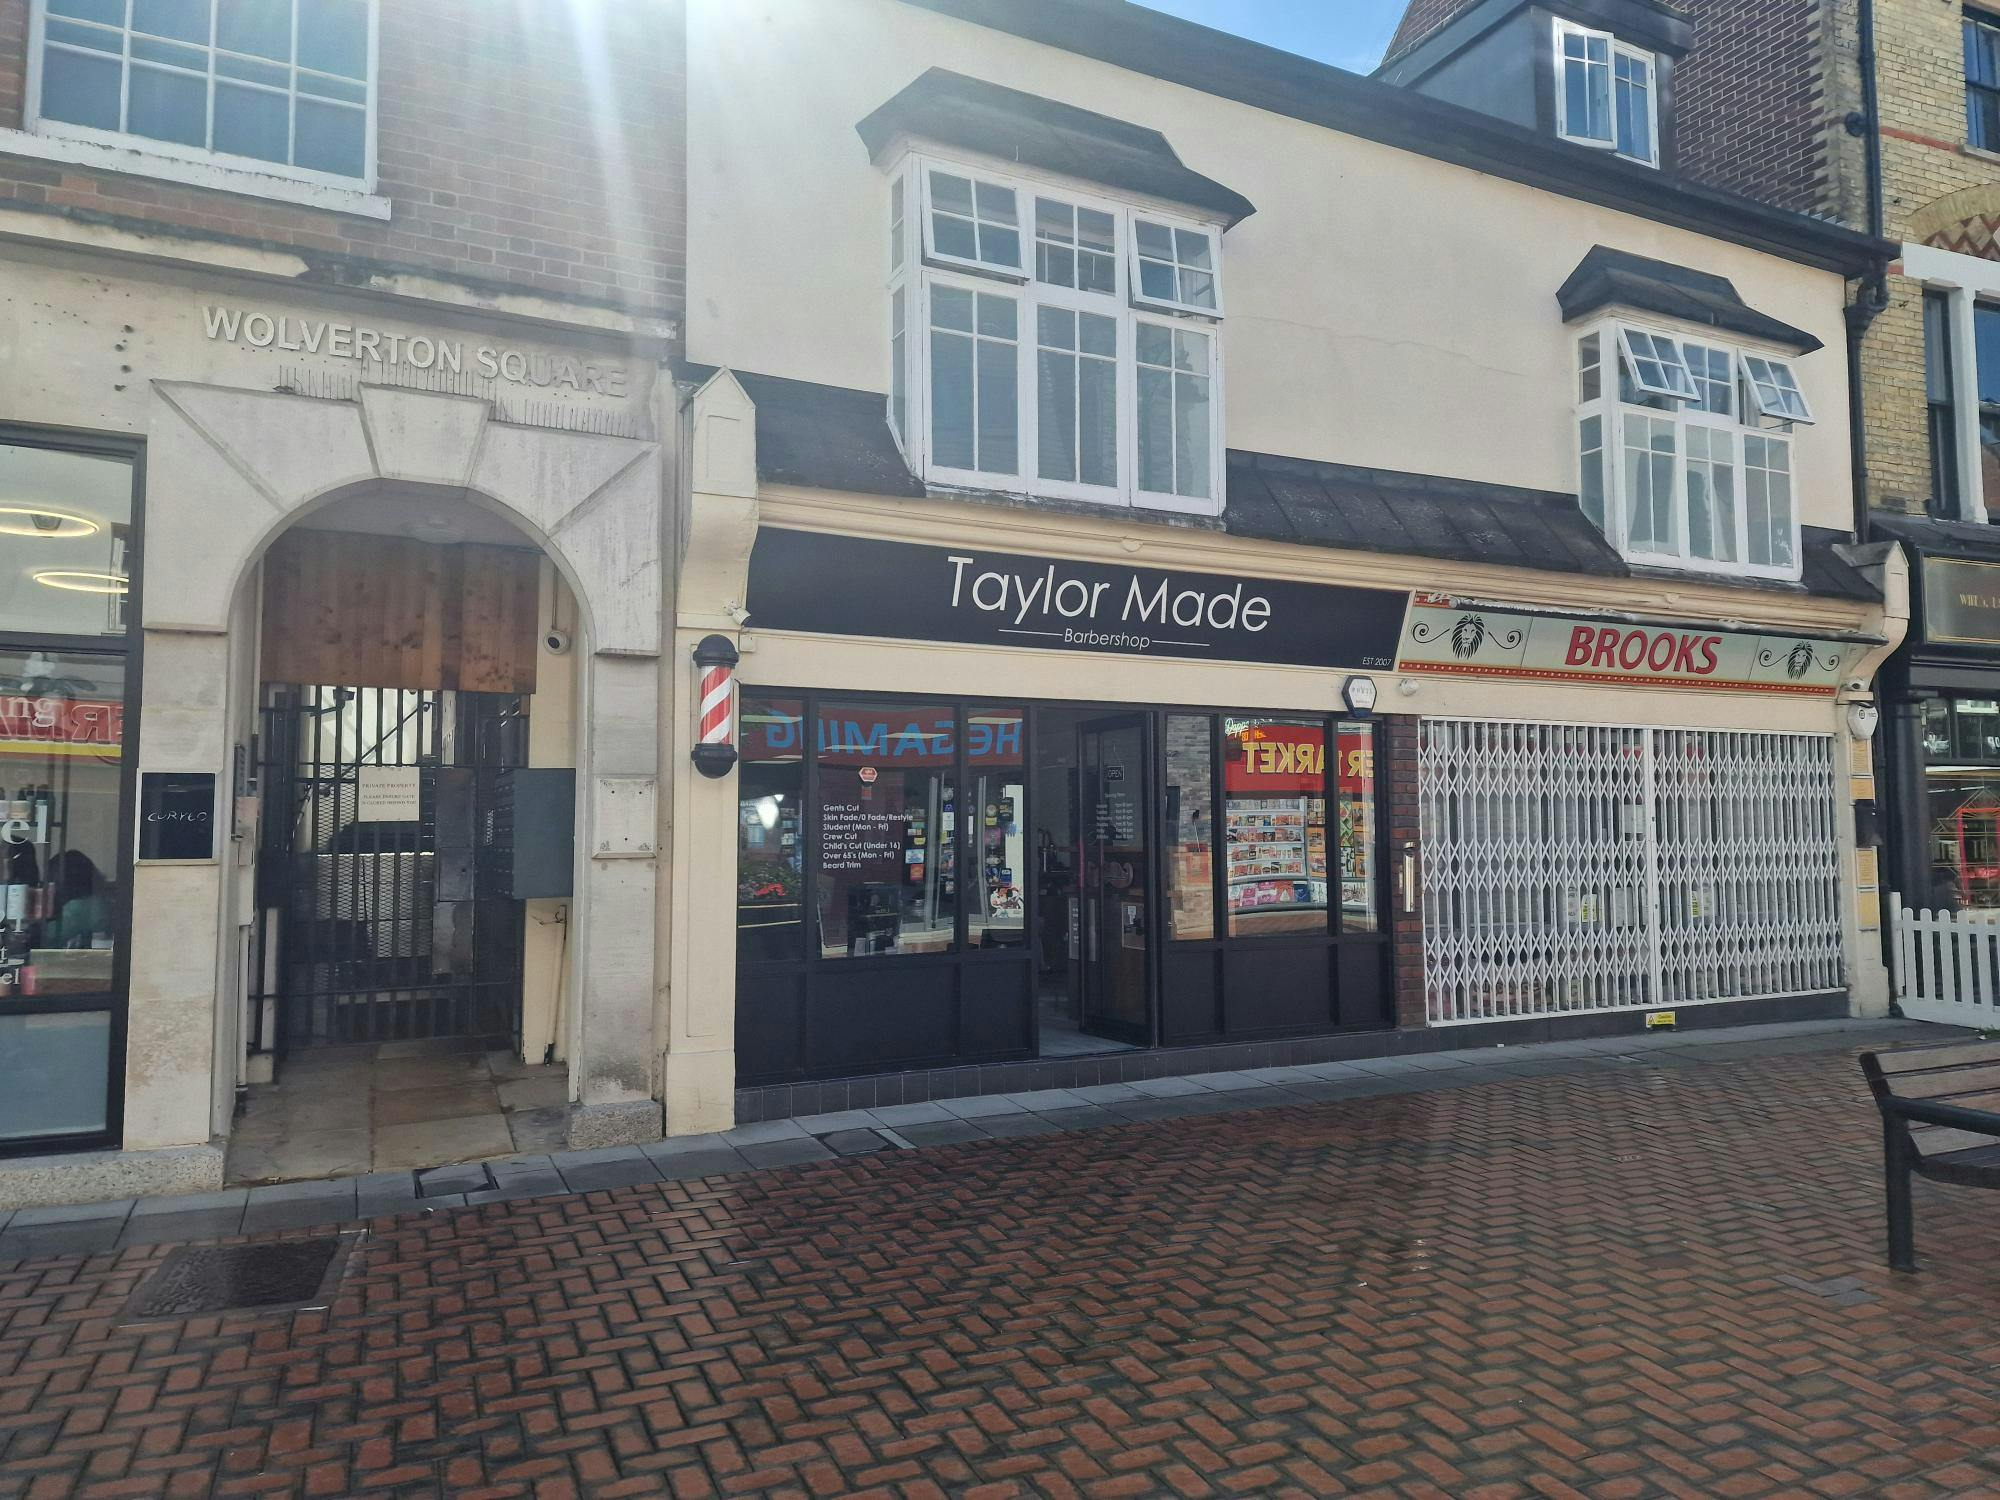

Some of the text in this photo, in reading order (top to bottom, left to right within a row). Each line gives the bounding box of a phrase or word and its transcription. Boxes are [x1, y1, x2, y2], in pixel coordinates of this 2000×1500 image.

[202, 305, 628, 398] WOLVERTON SQUARE
[947, 555, 1272, 632] Taylor Made
[1064, 628, 1151, 648] Barbershop
[1565, 625, 1723, 675] BROOKS
[1362, 656, 1392, 667] EST 2007
[1107, 769, 1122, 778] OPEN
[823, 804, 860, 812] Gents Cut
[823, 813, 914, 822] Skin Fade/0 Fade/Restyle
[822, 823, 851, 831] Student
[852, 823, 871, 832] (Mon
[878, 823, 889, 832] Fri)
[844, 832, 858, 840] Cut
[822, 842, 847, 850] Child's
[863, 842, 887, 850] (Under
[889, 841, 900, 850] 16)
[822, 852, 841, 860] Over
[858, 851, 877, 860] (Mon
[883, 851, 895, 860] Fri)
[822, 861, 845, 869] Beard
